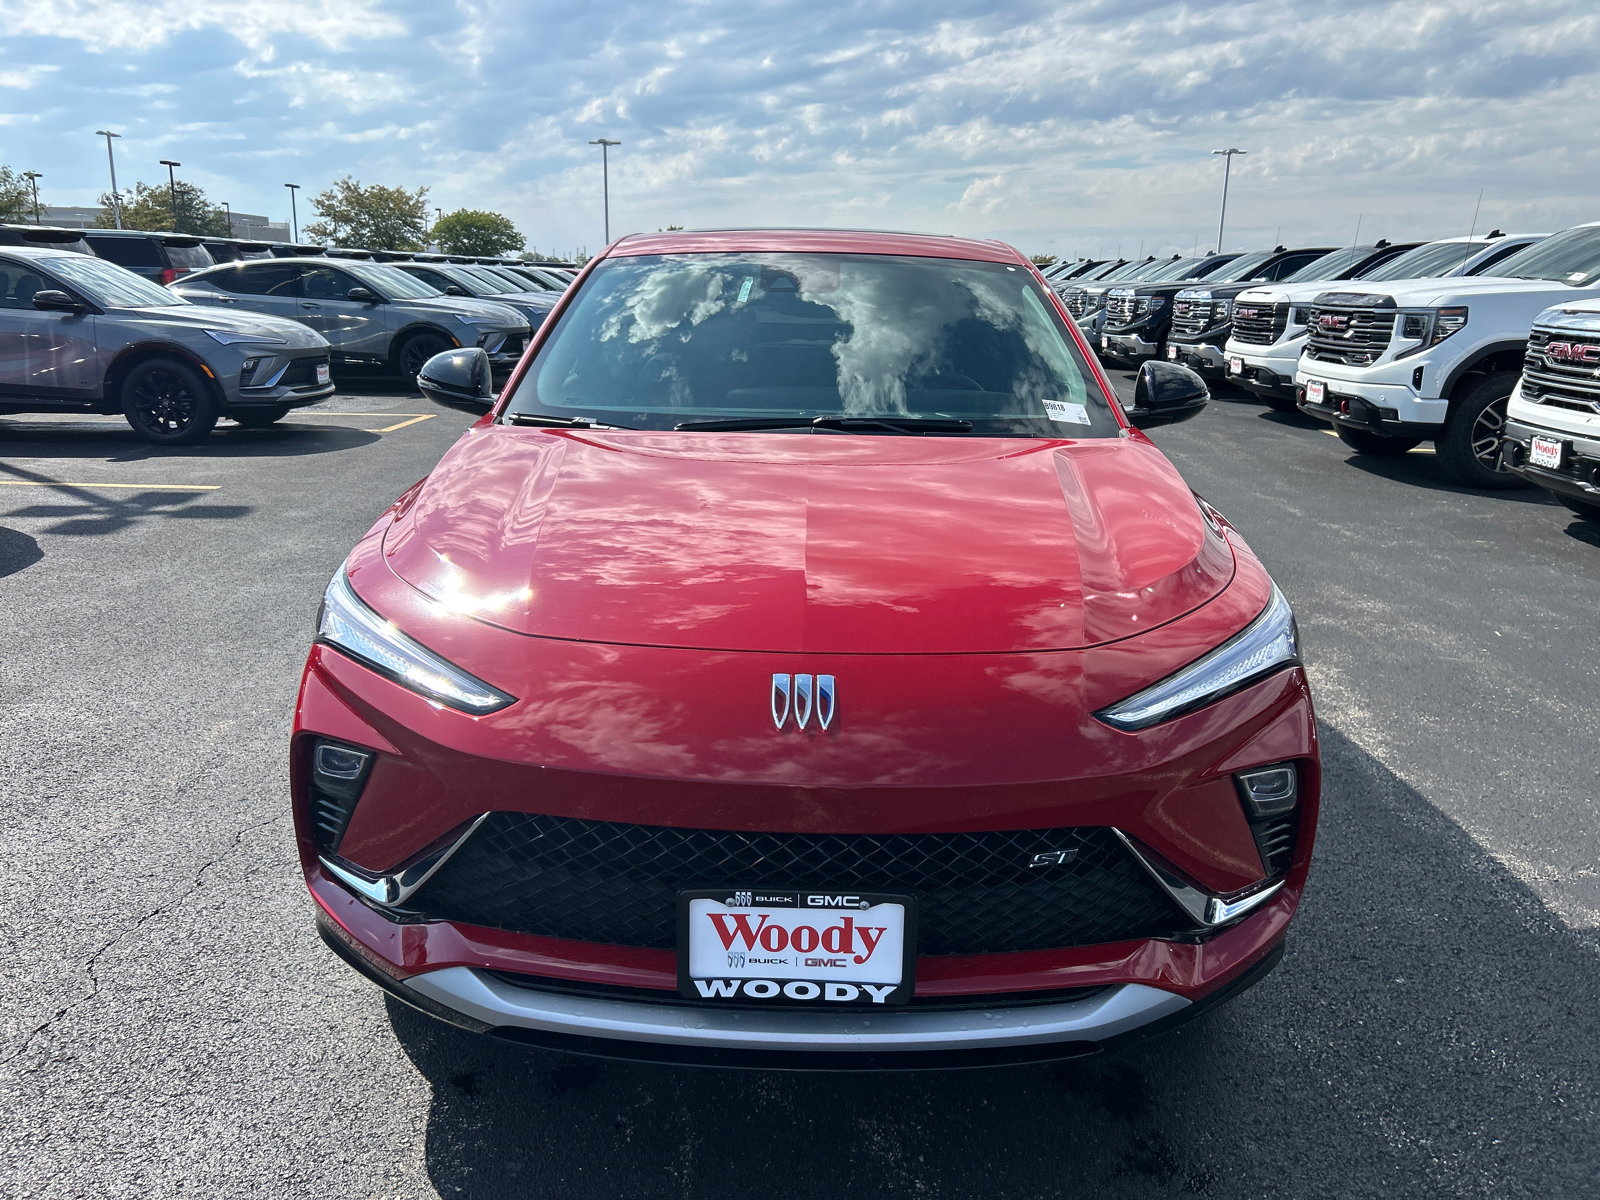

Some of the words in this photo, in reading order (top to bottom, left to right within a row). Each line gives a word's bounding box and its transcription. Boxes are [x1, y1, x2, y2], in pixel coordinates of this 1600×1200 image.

[1547, 341, 1600, 362] GMC
[1534, 440, 1559, 457] Woody
[755, 895, 793, 903] BUICK
[807, 895, 860, 907] GMC
[706, 913, 888, 965] Woody
[748, 957, 789, 965] BUICK
[804, 957, 847, 968] GMC
[693, 980, 898, 1004] WOODY
